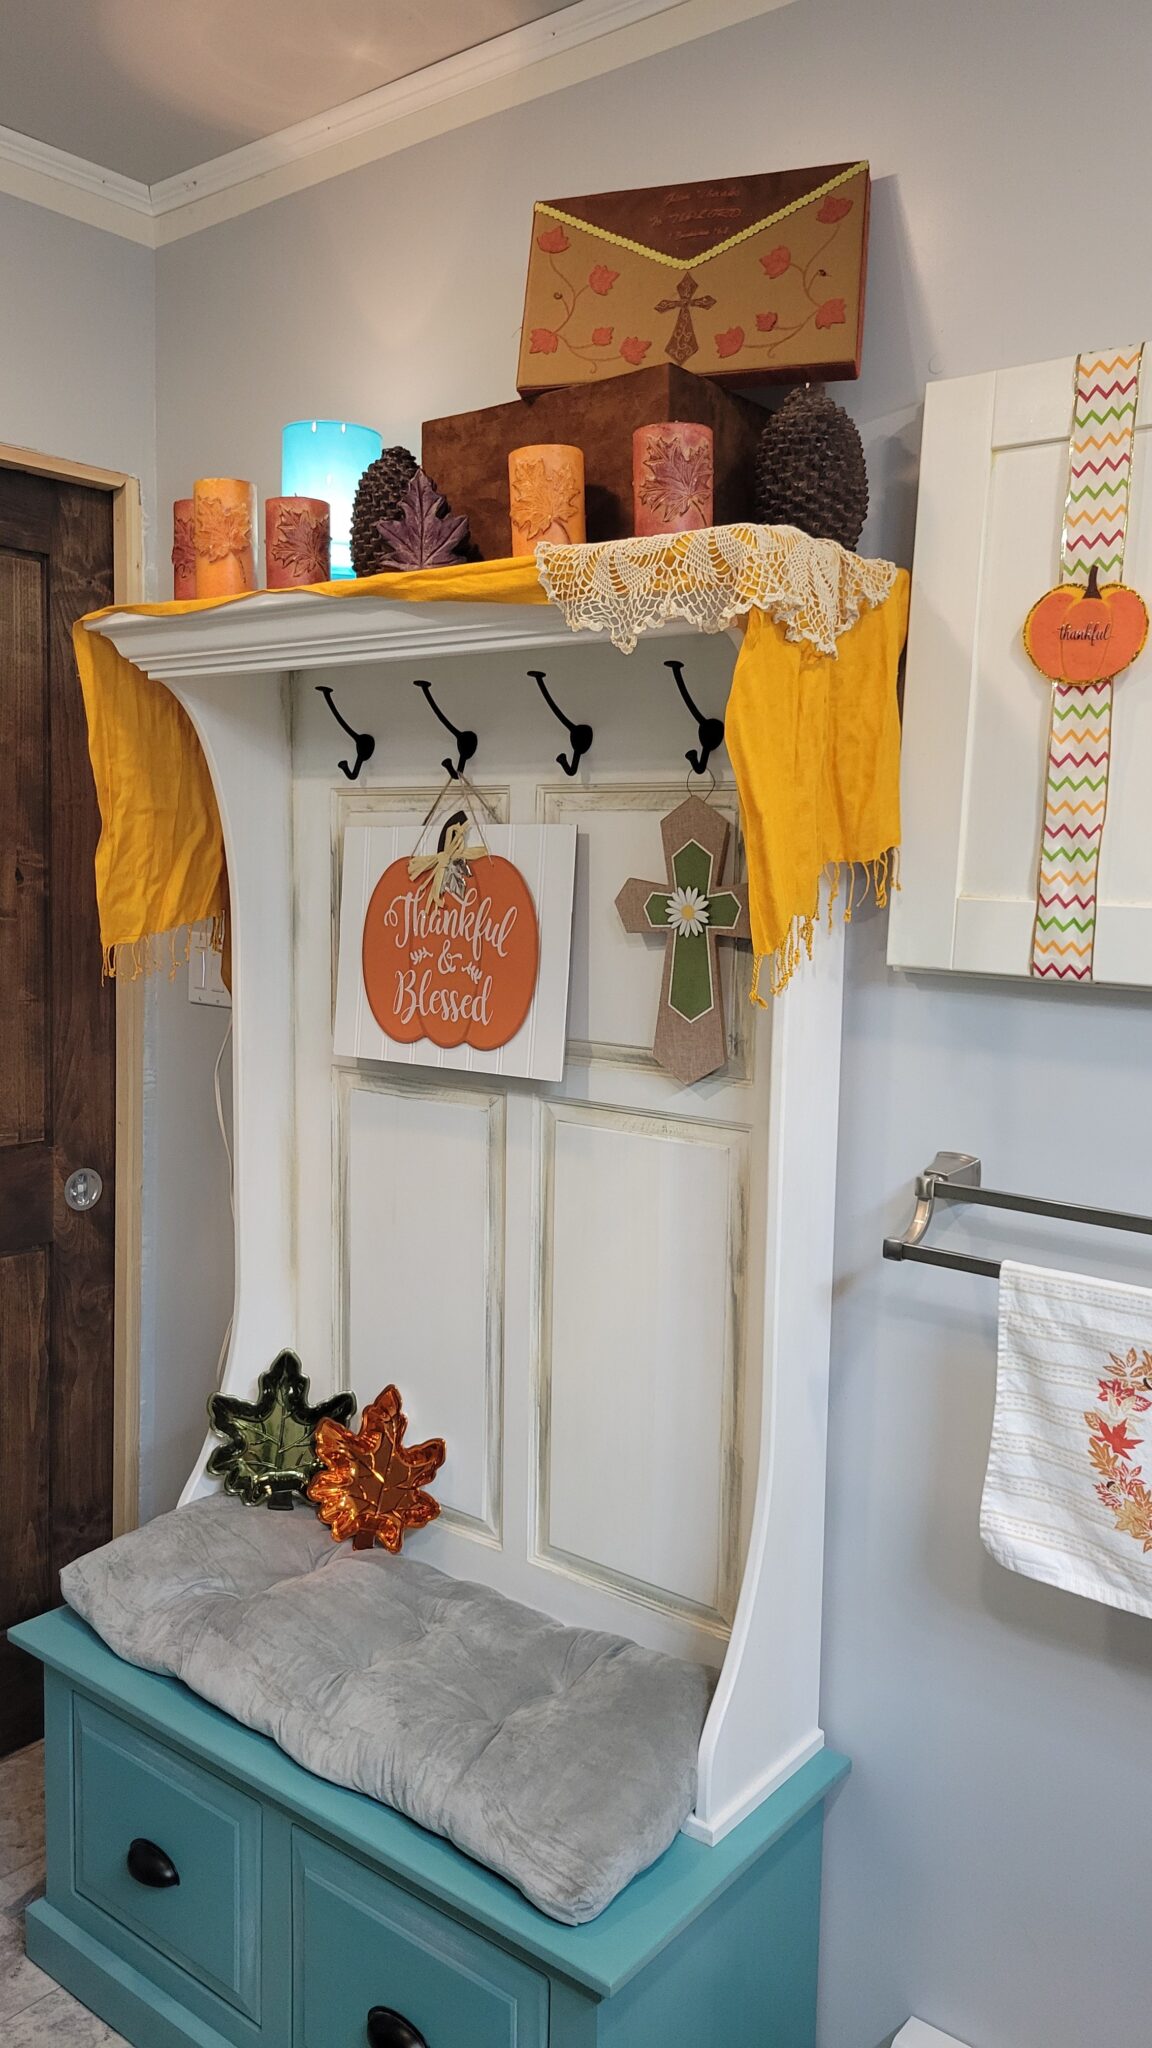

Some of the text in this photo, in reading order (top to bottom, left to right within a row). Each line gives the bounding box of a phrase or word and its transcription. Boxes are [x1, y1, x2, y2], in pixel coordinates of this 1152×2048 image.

[1057, 623, 1111, 646] thankful
[384, 887, 518, 961] Thankful
[437, 939, 463, 975] &
[393, 969, 494, 1026] Blessed
